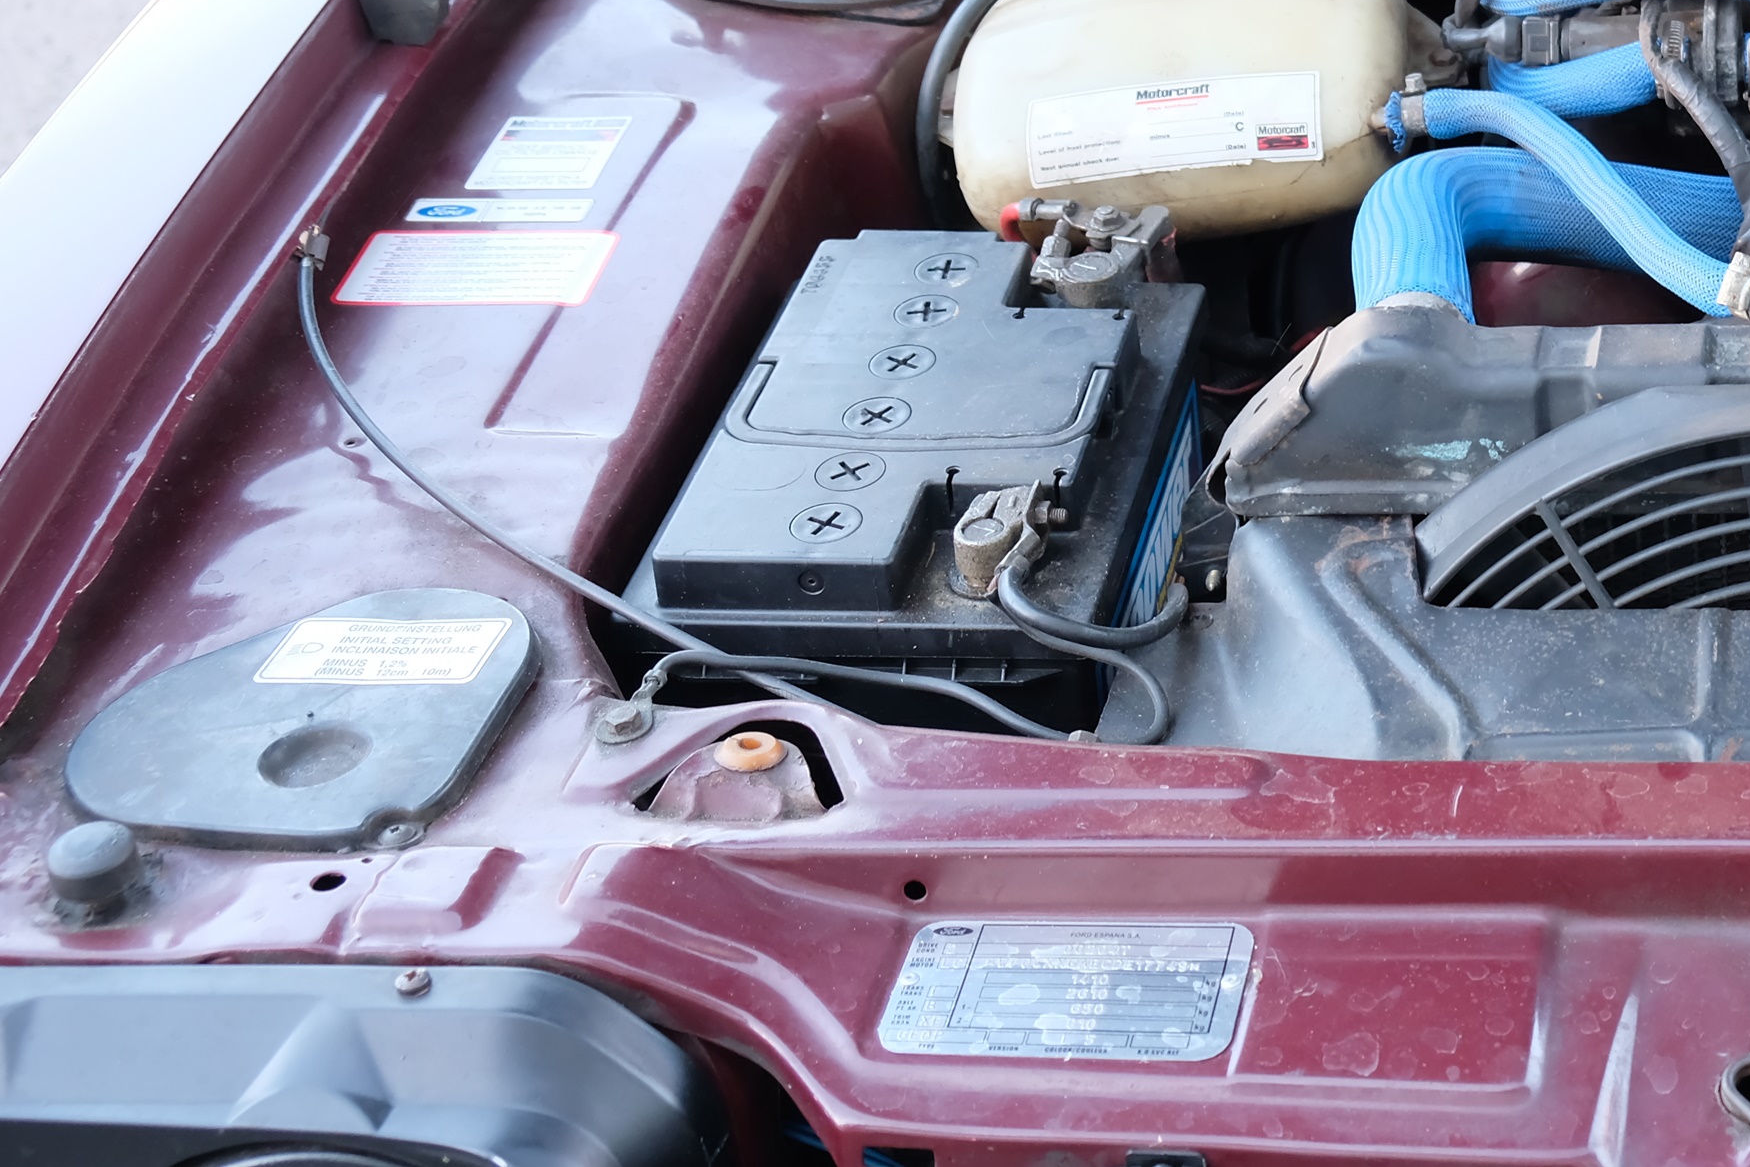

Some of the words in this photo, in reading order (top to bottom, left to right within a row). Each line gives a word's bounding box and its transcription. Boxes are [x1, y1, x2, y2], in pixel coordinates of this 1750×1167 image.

[1135, 83, 1210, 100] Motorcraft
[1258, 125, 1306, 135] Motorcraft
[348, 624, 482, 633] GRUNDEINSTELLUNG
[339, 636, 388, 644] INITIAL
[391, 636, 453, 645] SETTING
[330, 645, 420, 655] INCLINAISON
[421, 645, 478, 654] INITIALE
[322, 658, 368, 667] MINUS
[314, 667, 365, 677] (MINUS
[376, 669, 409, 677] 12cm
[421, 667, 452, 677] 10m)
